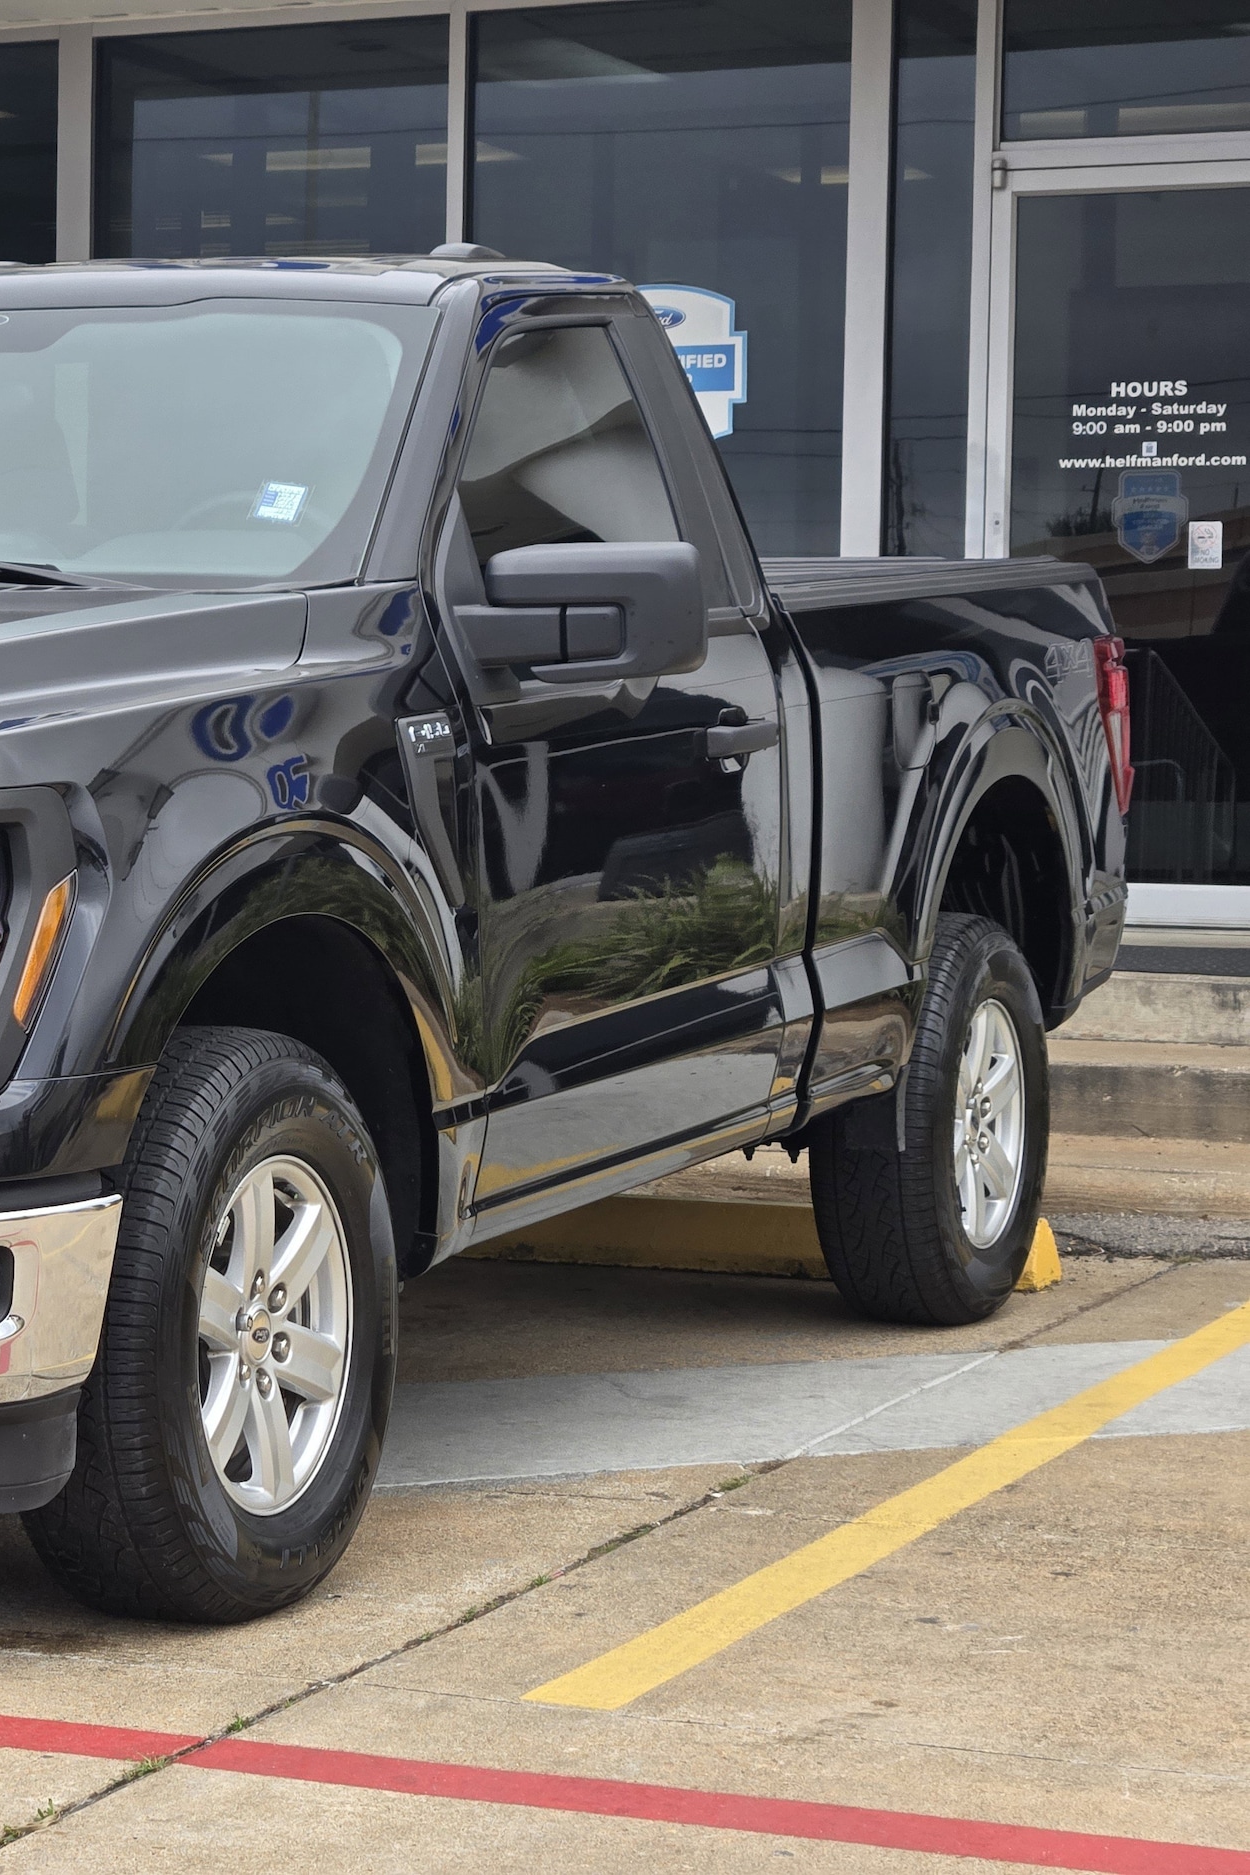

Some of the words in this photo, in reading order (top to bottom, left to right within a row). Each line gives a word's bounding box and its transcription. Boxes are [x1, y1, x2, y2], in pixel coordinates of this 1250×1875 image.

[1110, 380, 1188, 397] HOURS
[1072, 404, 1136, 418] Monday
[1151, 401, 1227, 417] Saturday
[1072, 421, 1107, 435] 9:00
[1113, 423, 1140, 434] am
[1156, 420, 1194, 433] 9:00
[1199, 421, 1227, 435] pm
[1058, 453, 1247, 468] www.helfmanford.com
[319, 1110, 367, 1166] ATR
